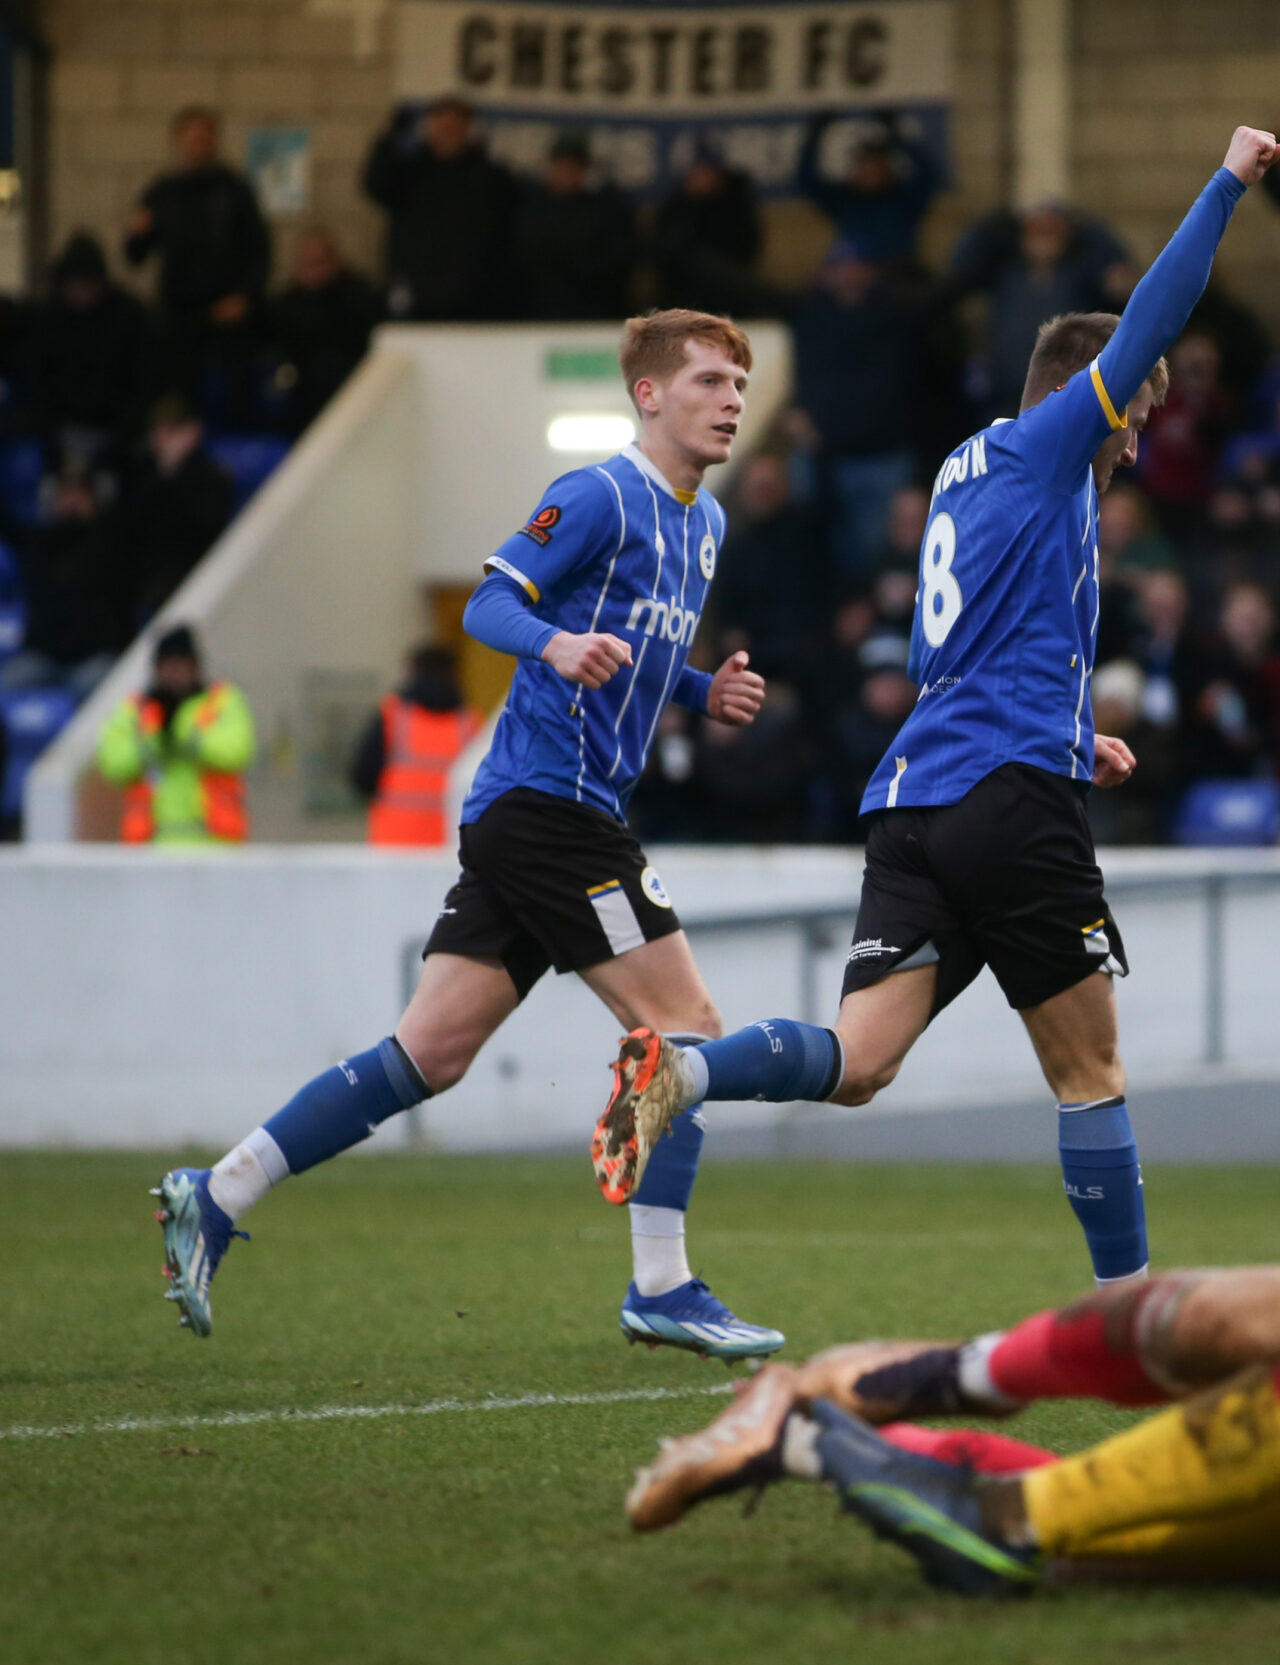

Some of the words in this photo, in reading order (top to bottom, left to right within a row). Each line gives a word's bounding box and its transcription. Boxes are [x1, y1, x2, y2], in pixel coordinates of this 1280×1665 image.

[457, 14, 776, 96] CHESTER
[806, 16, 888, 90] FC
[921, 511, 963, 648] 8
